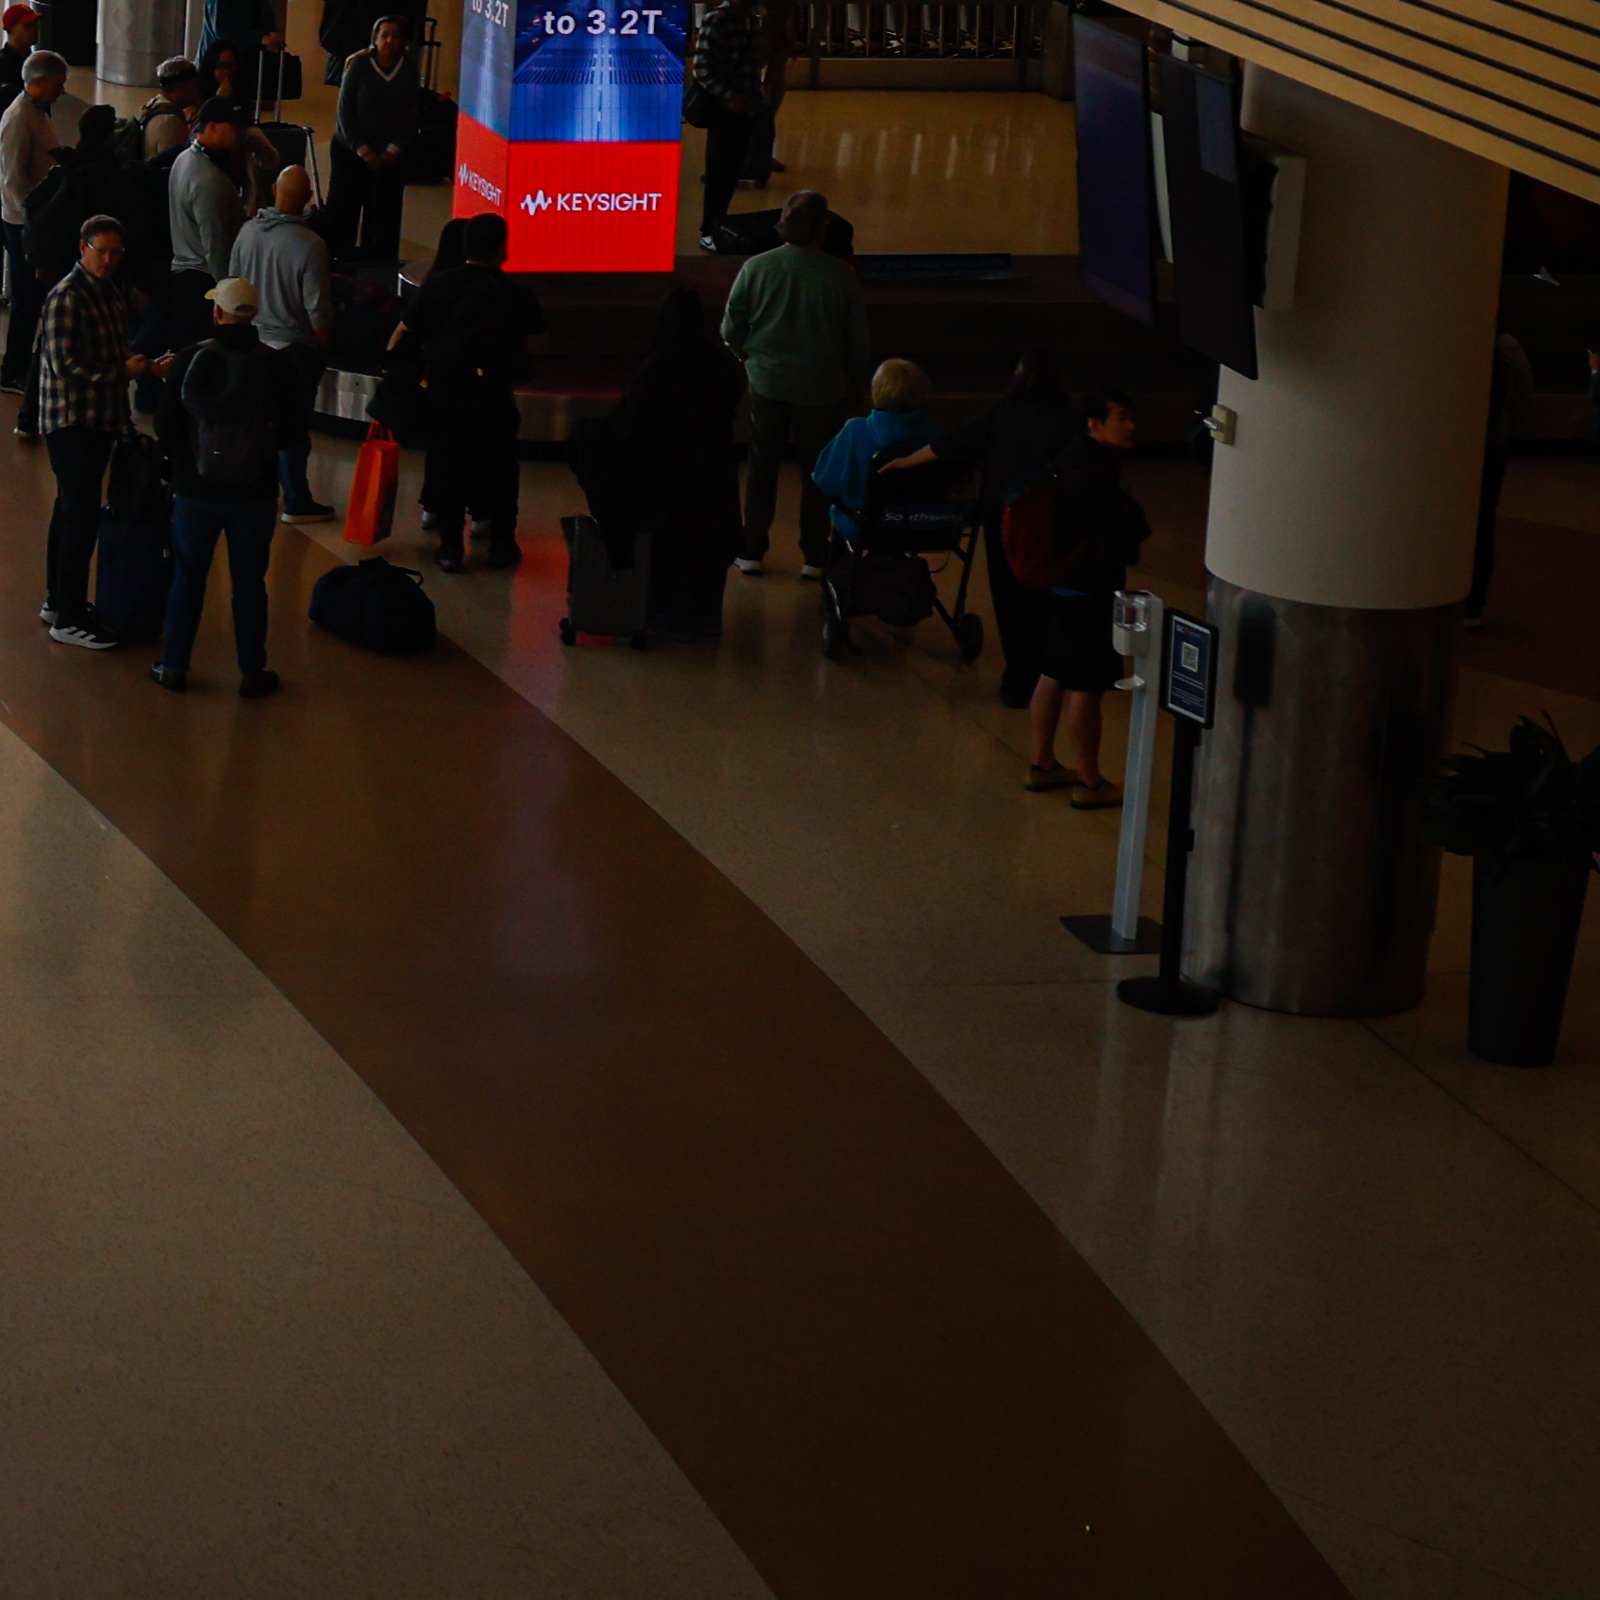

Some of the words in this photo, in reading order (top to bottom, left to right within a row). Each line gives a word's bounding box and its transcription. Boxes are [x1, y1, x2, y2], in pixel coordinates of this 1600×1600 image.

[543, 11, 575, 34] to
[586, 9, 663, 35] 3.2T
[468, 170, 502, 208] KEYSIGHT
[557, 193, 663, 212] KEYSIGHT
